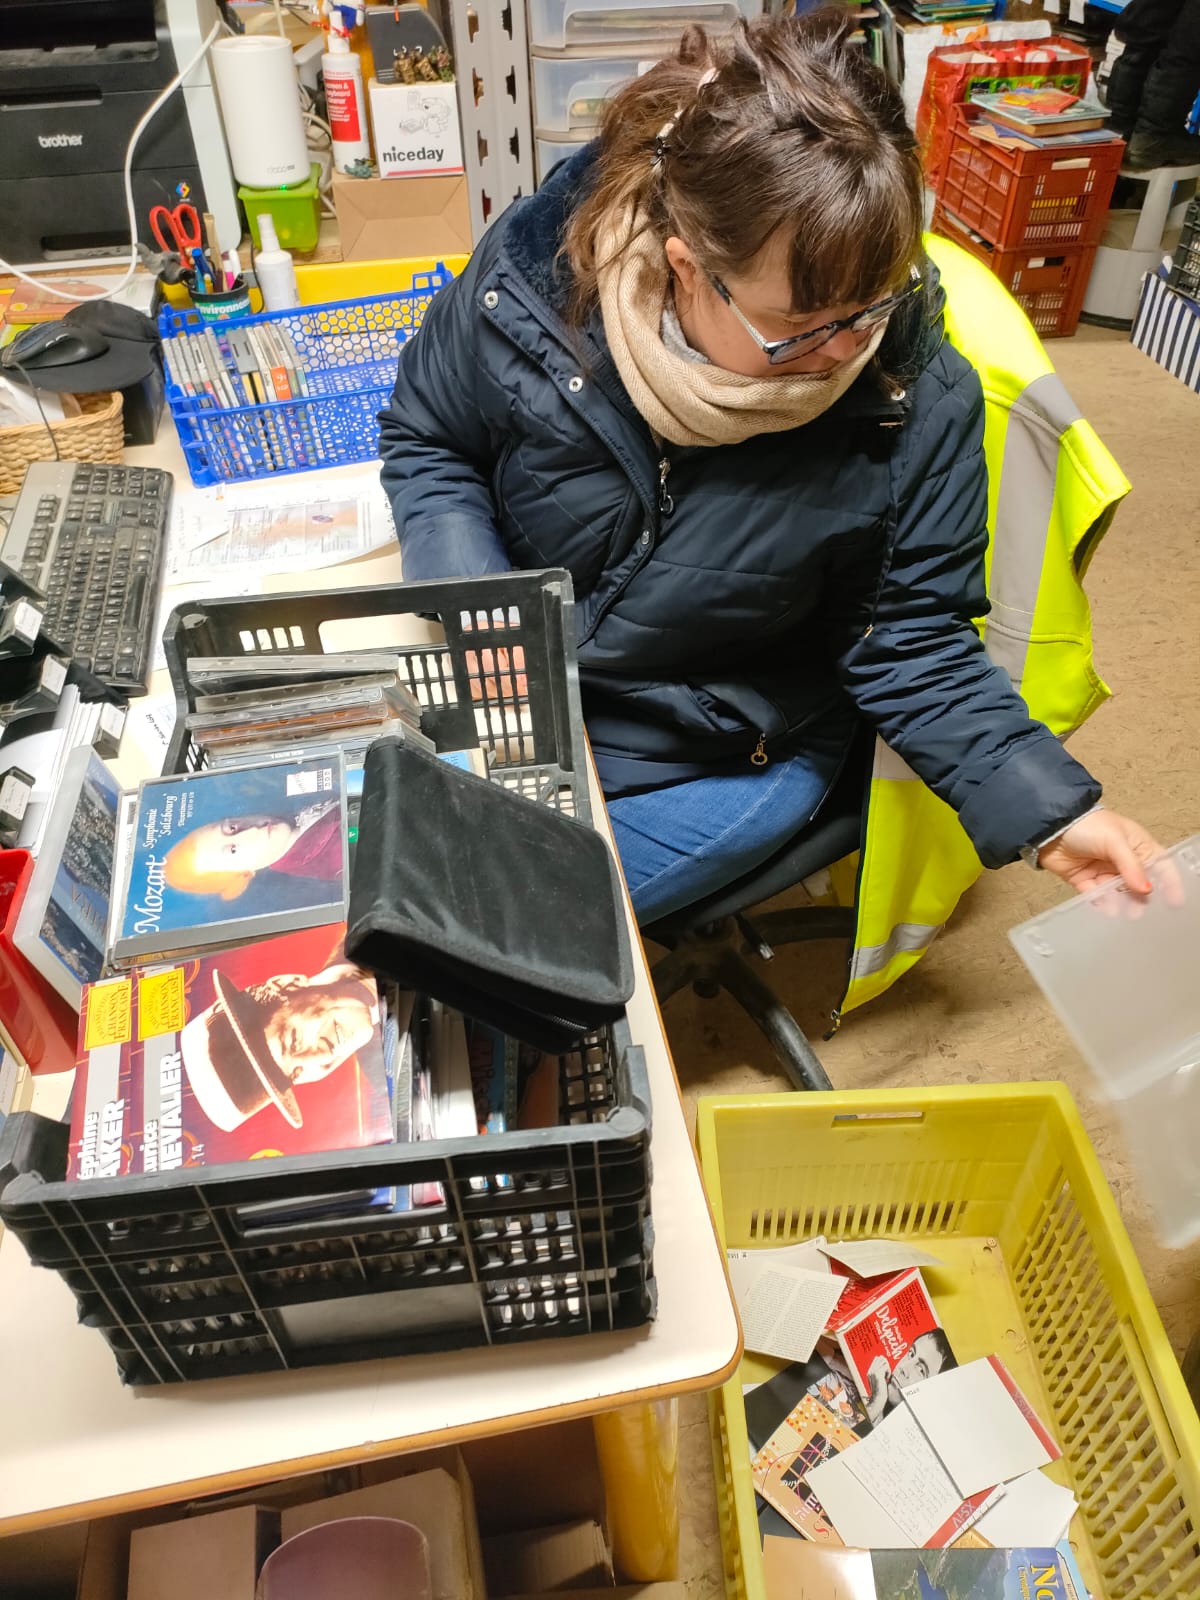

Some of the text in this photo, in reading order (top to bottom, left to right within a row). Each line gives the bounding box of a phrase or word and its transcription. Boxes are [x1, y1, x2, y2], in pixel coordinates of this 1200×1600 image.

[38, 134, 83, 148] brother
[382, 146, 444, 162] niceday
[142, 808, 159, 849] Symphonie
[133, 854, 168, 934] Mozart
[107, 990, 119, 1039] CHANSON
[159, 979, 171, 1027] CHANSON
[159, 1051, 182, 1171] EVALIER
[76, 1111, 99, 1181] éphine
[99, 1098, 125, 1179] AKER
[140, 1119, 158, 1173] urice
[191, 1143, 205, 1161] 14
[875, 1305, 908, 1360] Delpech
